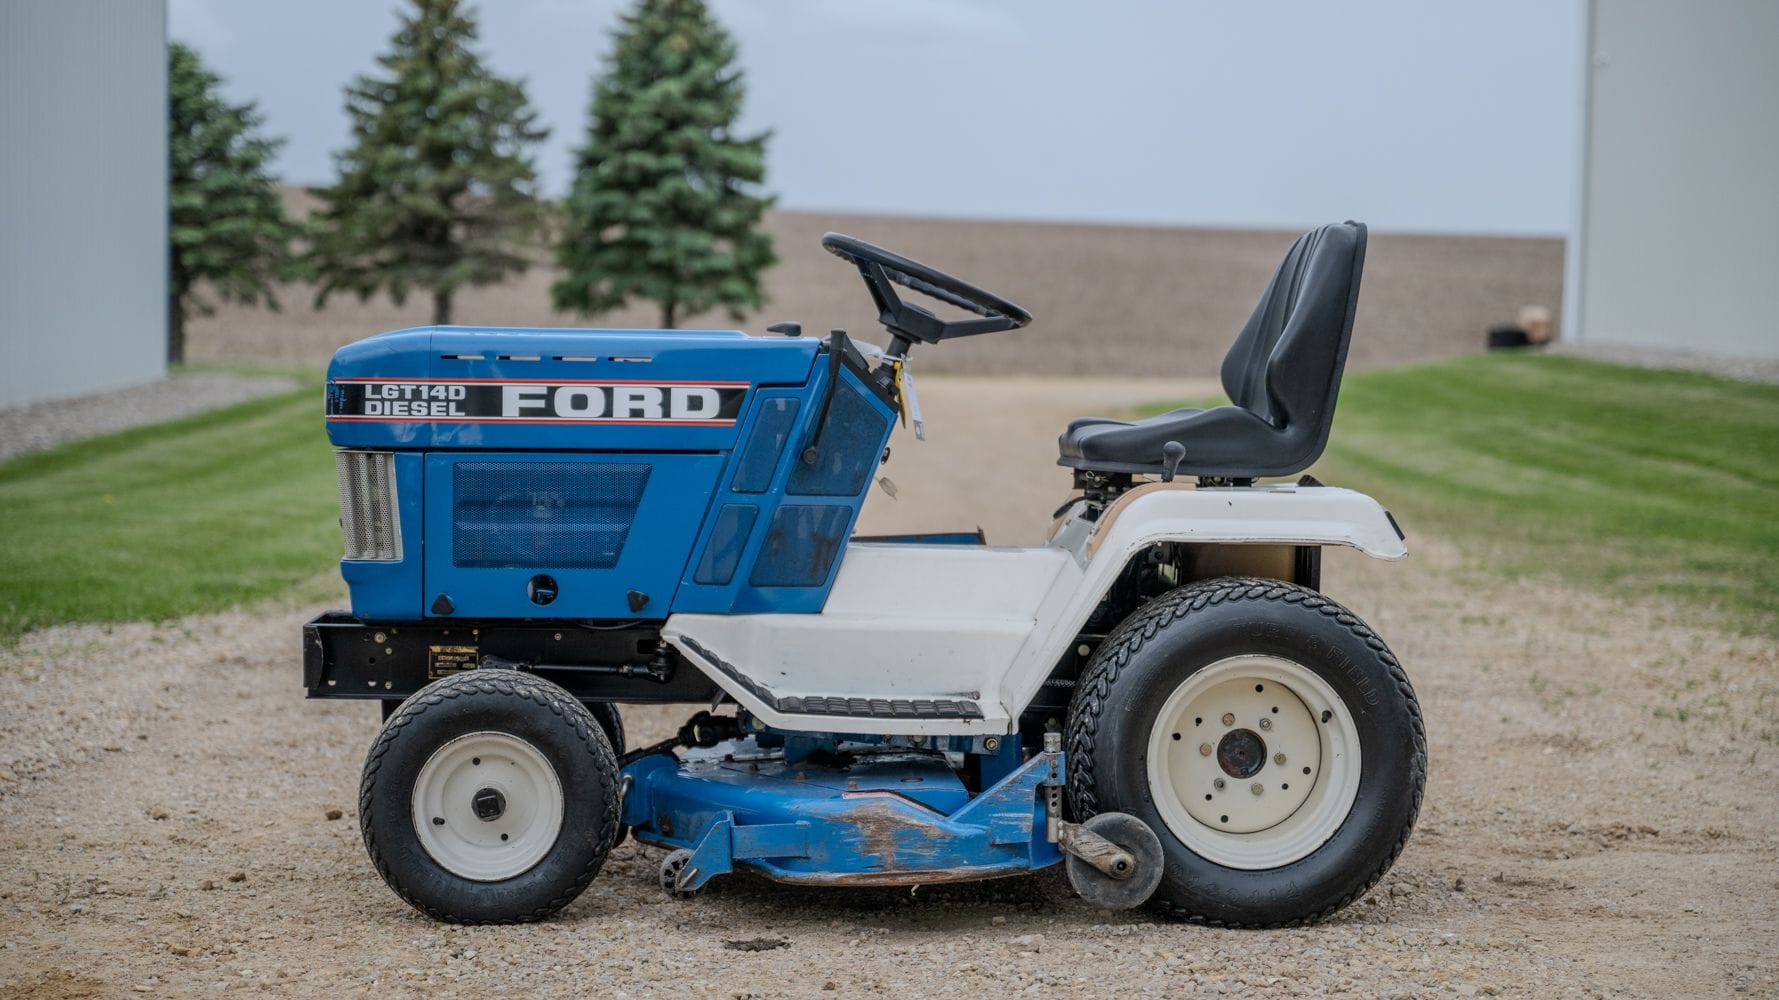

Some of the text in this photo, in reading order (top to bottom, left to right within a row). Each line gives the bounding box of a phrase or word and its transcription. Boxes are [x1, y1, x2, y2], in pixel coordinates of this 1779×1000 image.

[364, 384, 466, 400] LGT14D
[501, 385, 720, 419] FORD
[364, 401, 466, 417] DIESEL
[1326, 645, 1379, 706] FIELD
